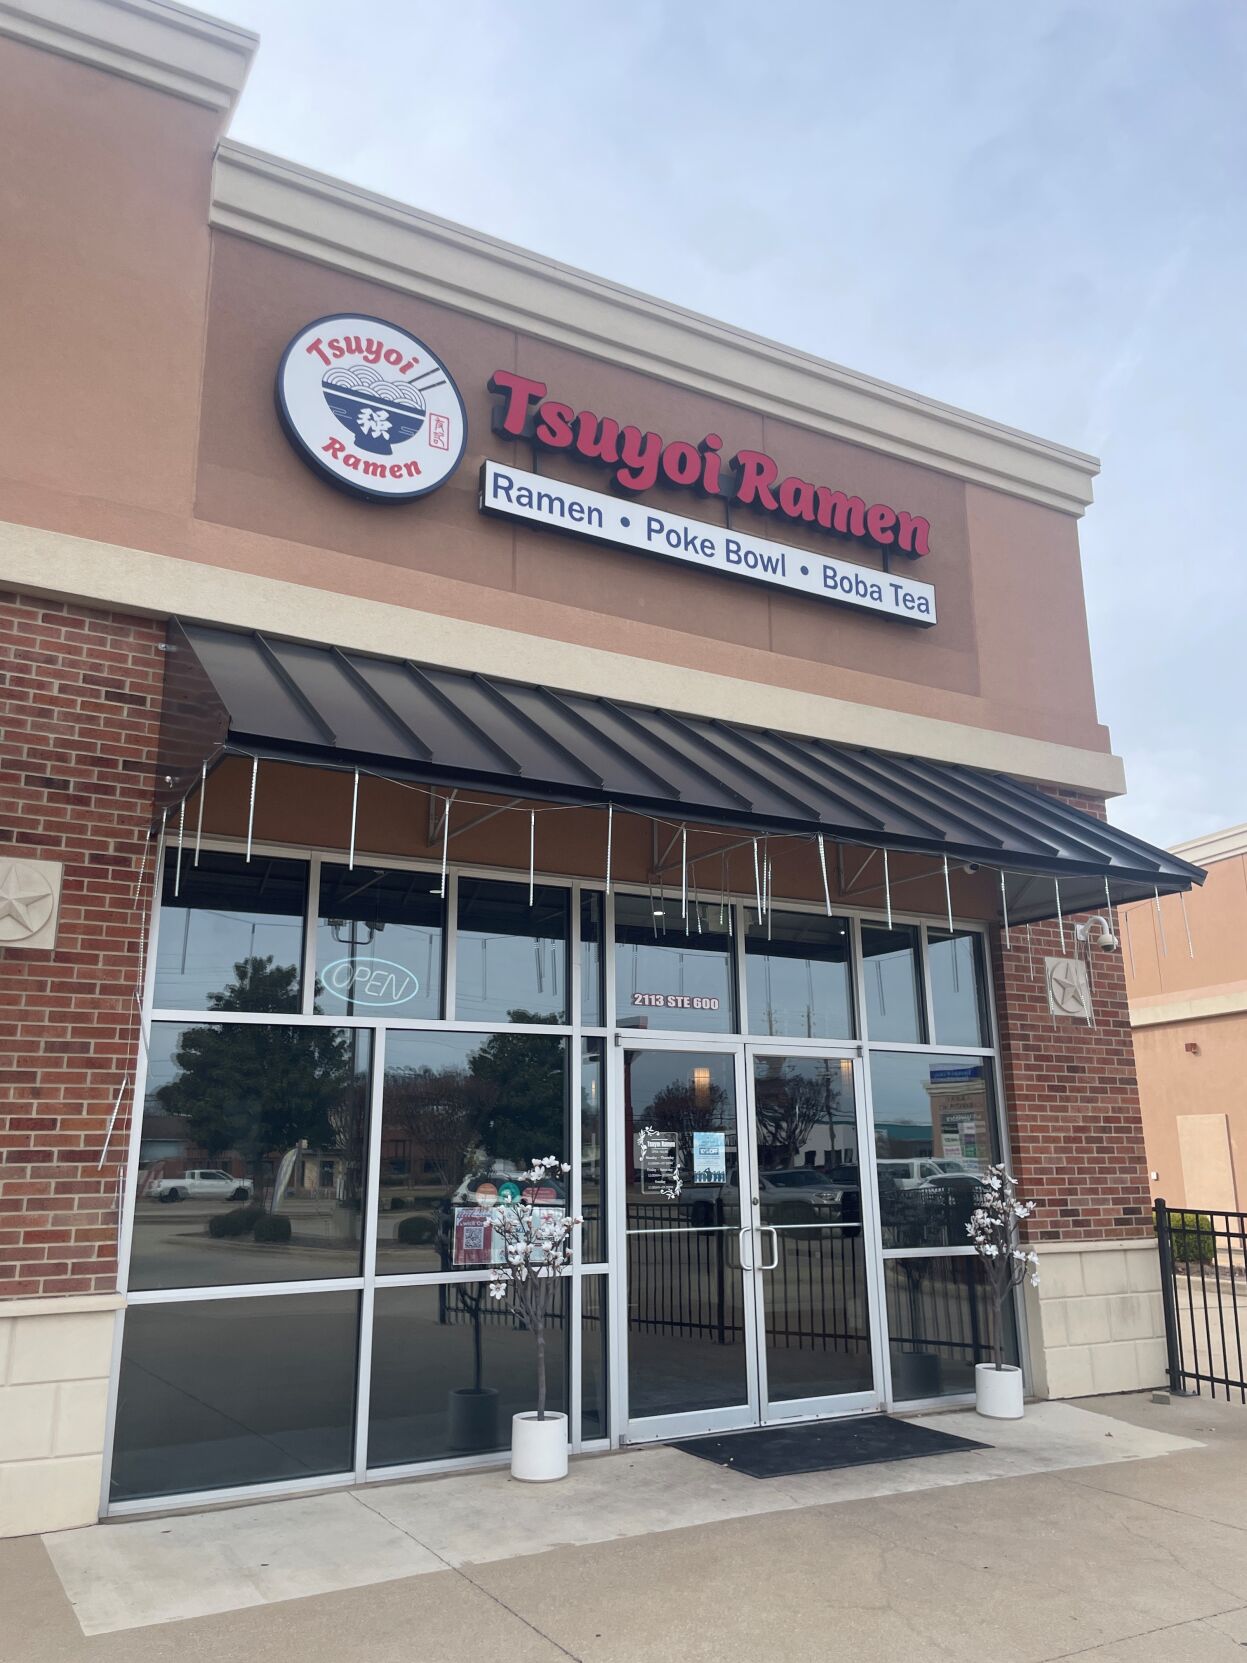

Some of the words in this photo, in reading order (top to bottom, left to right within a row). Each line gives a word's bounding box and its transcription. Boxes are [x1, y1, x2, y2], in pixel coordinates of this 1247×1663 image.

[306, 336, 420, 375] Tsuyoi
[322, 436, 422, 479] Ramen
[490, 369, 723, 494] Tsuyoi
[732, 449, 930, 556] Ramen
[491, 471, 603, 528] Ramen
[646, 516, 716, 558] Poke
[726, 538, 787, 577] Bowl
[823, 564, 883, 602] Boba
[889, 582, 931, 614] Tea
[333, 963, 410, 1000] OPEN
[633, 993, 665, 1007] 2113
[667, 995, 691, 1009] STE
[693, 997, 720, 1011] 600
